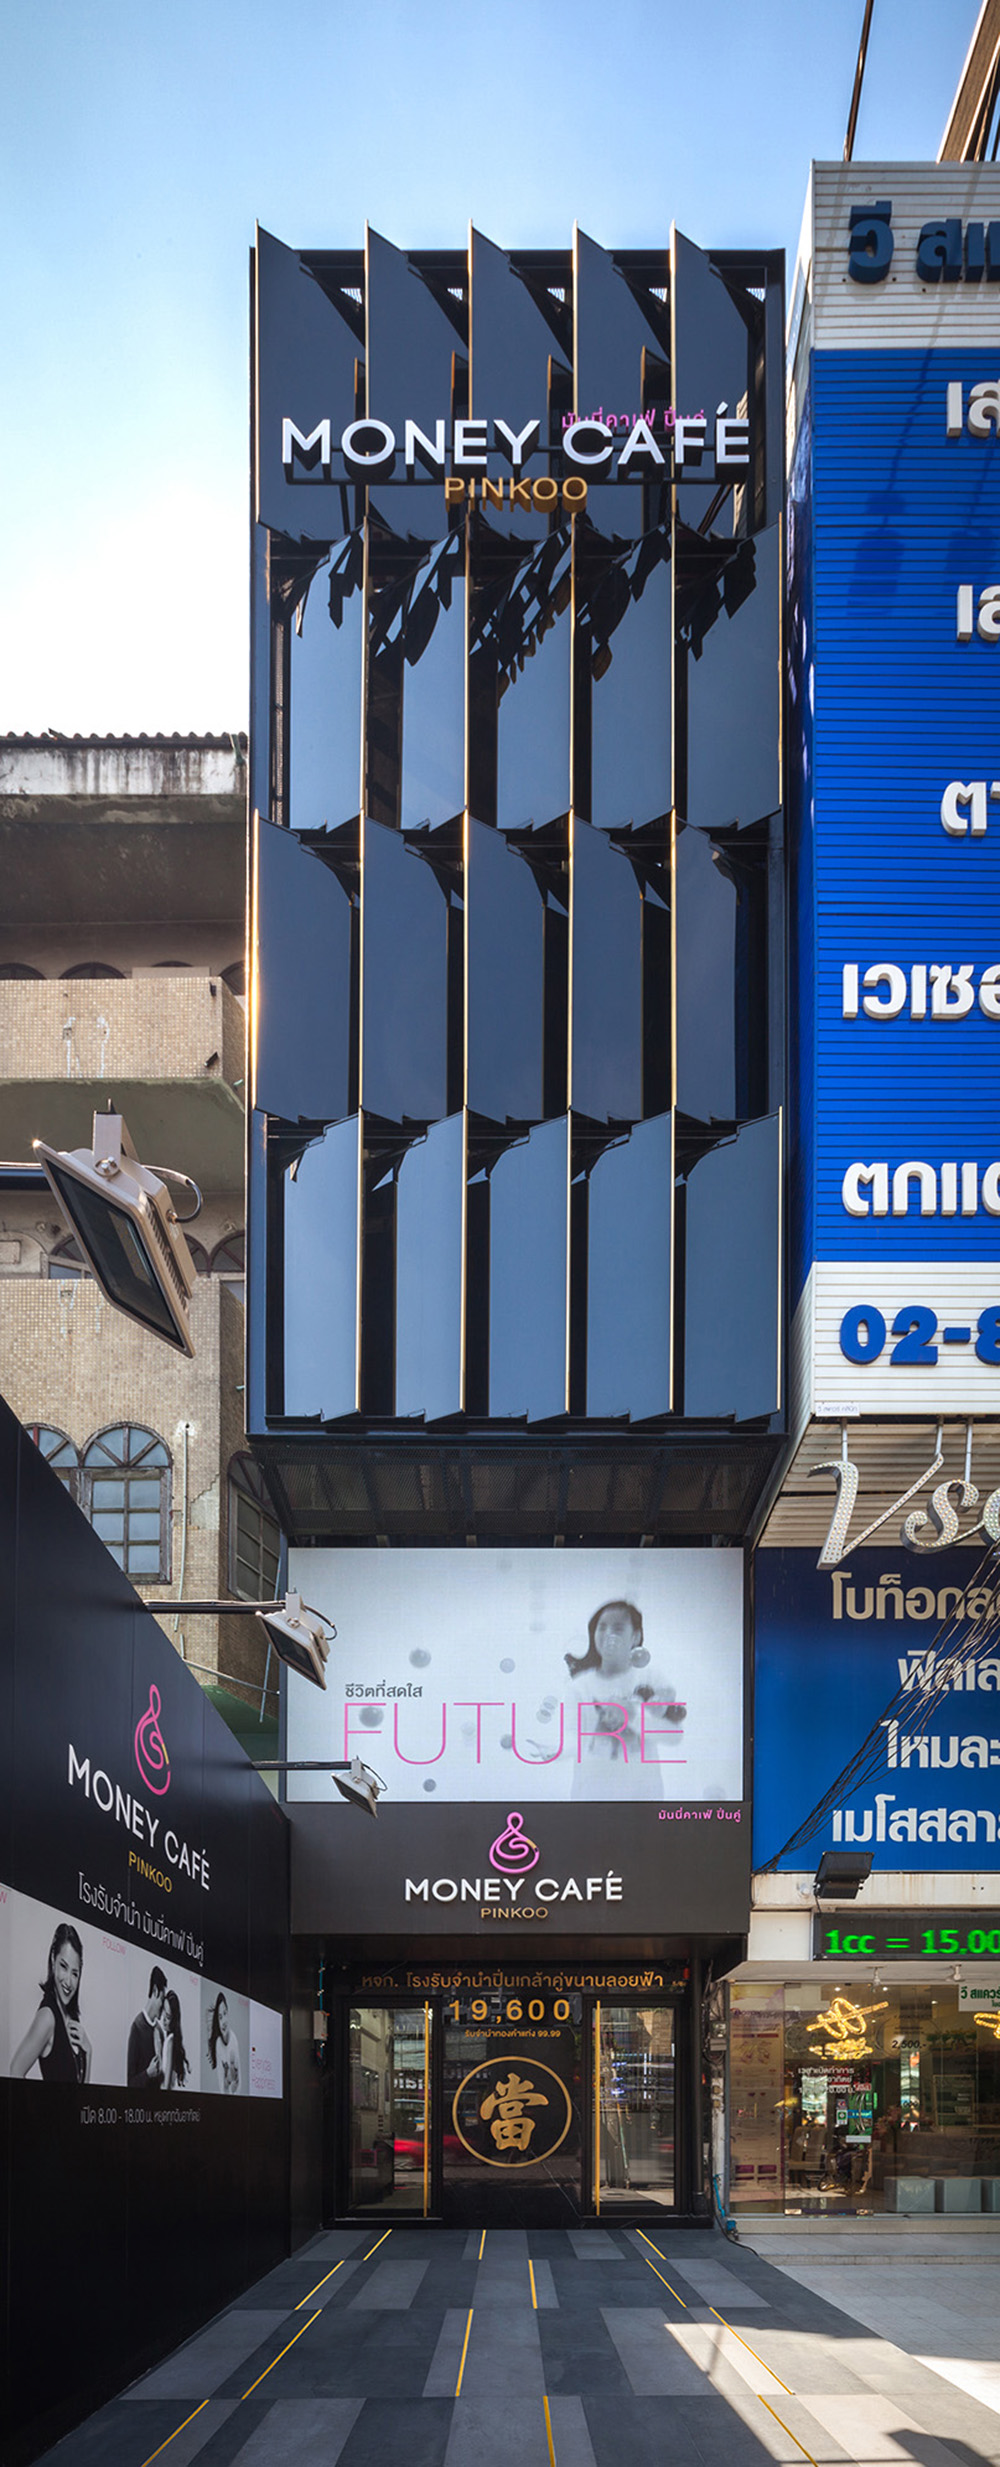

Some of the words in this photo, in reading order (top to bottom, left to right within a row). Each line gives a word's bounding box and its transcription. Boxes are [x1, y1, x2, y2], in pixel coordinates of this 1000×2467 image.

[849, 201, 894, 276] วี
[281, 417, 541, 466] MONEY
[562, 401, 750, 466] CAFÉ
[444, 476, 588, 503] PINKOO
[831, 1571, 1000, 1620] โบท็อกล
[345, 1680, 423, 1698] ชีวิตที่สดใส
[344, 1702, 687, 1765] FUTURE
[68, 1743, 160, 1848] MONEY
[164, 1830, 210, 1891] CAFÉ
[833, 1794, 1000, 1842] เมโสสลา
[128, 1851, 172, 1893] PINKOO
[405, 1878, 525, 1901] MONEY
[535, 1870, 623, 1901] CAFÉ
[481, 1907, 549, 1919] PINKOO
[825, 1929, 876, 1954] 1cc
[362, 1976, 399, 1988] หจก.
[970, 1986, 1000, 1999] สแคว
[449, 1999, 570, 2024] 19,600
[537, 2030, 561, 2038] 99.99
[98, 2108, 117, 2124] 8.00
[480, 2072, 549, 2151] 當
